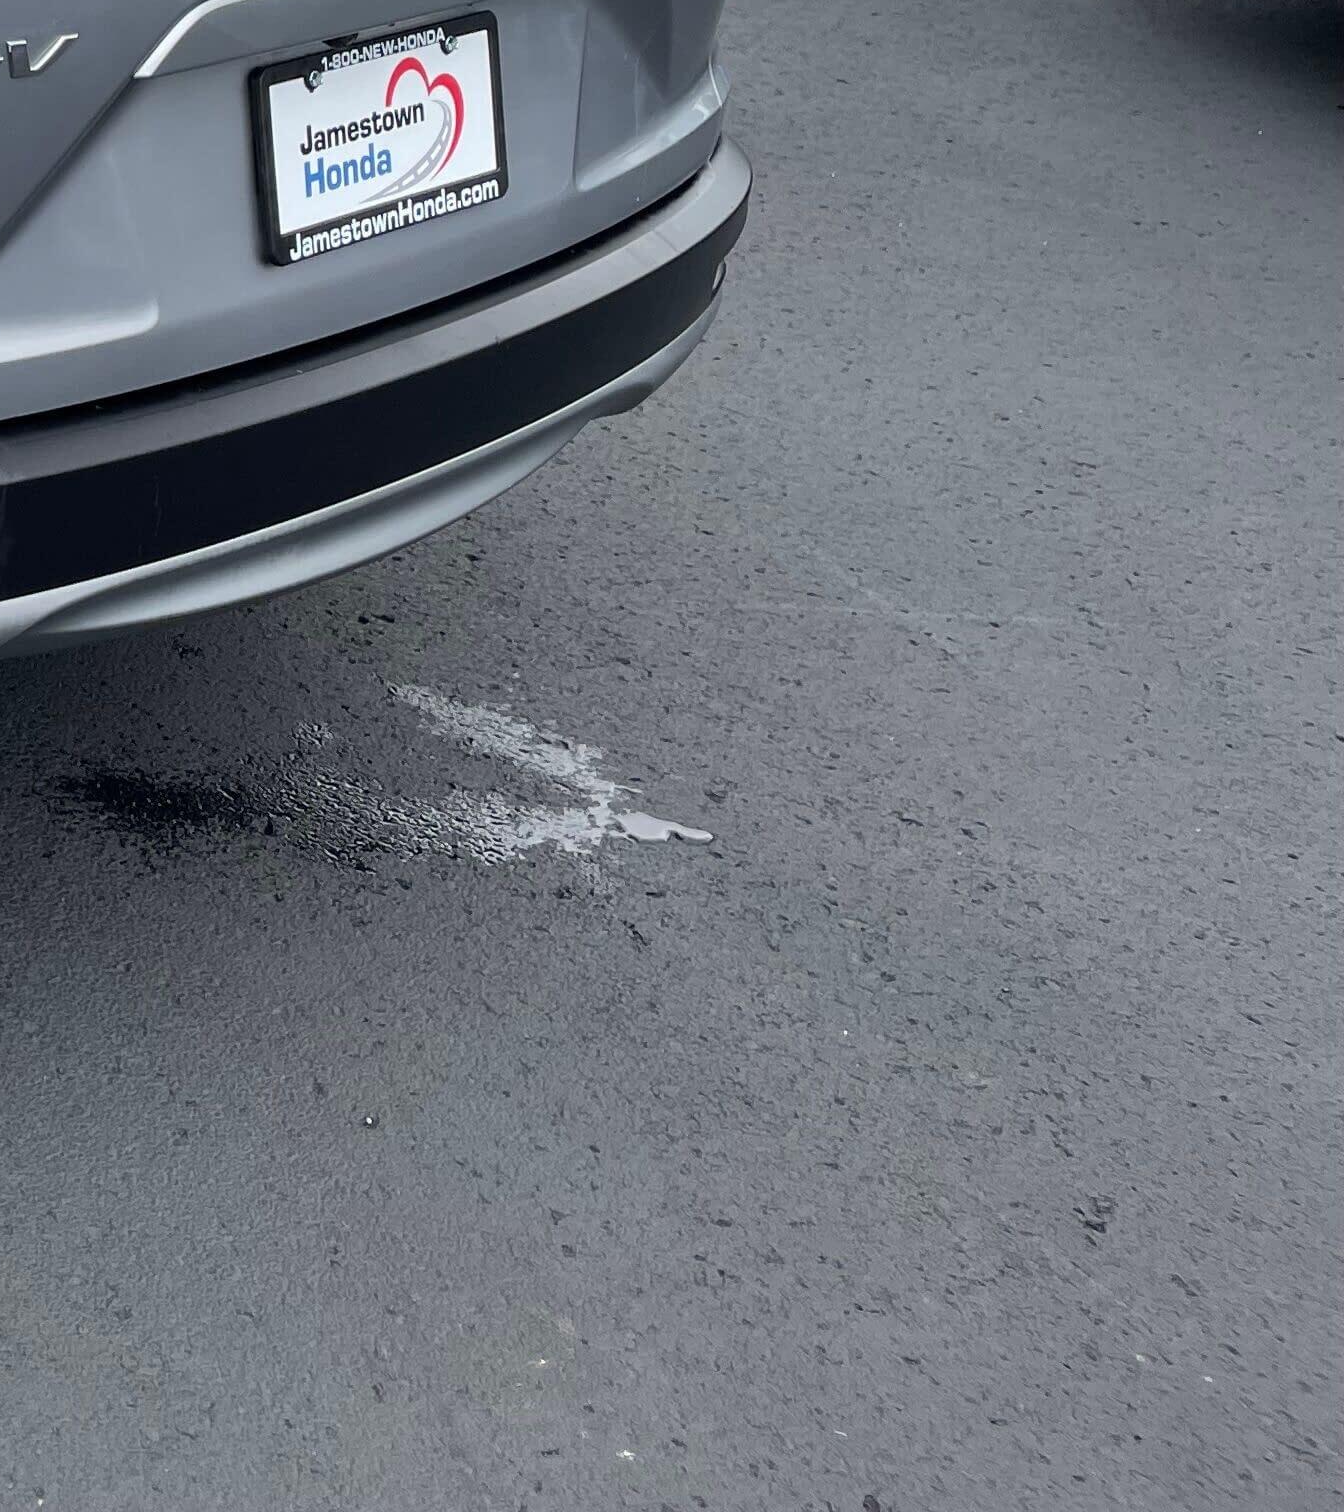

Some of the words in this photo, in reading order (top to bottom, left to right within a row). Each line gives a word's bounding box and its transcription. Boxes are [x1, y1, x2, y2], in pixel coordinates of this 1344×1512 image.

[321, 27, 446, 71] 1-800-NEW-HONDA
[300, 102, 425, 155] Jamestown
[304, 143, 392, 198] Honda
[290, 179, 499, 261] JamestownHonda.com
